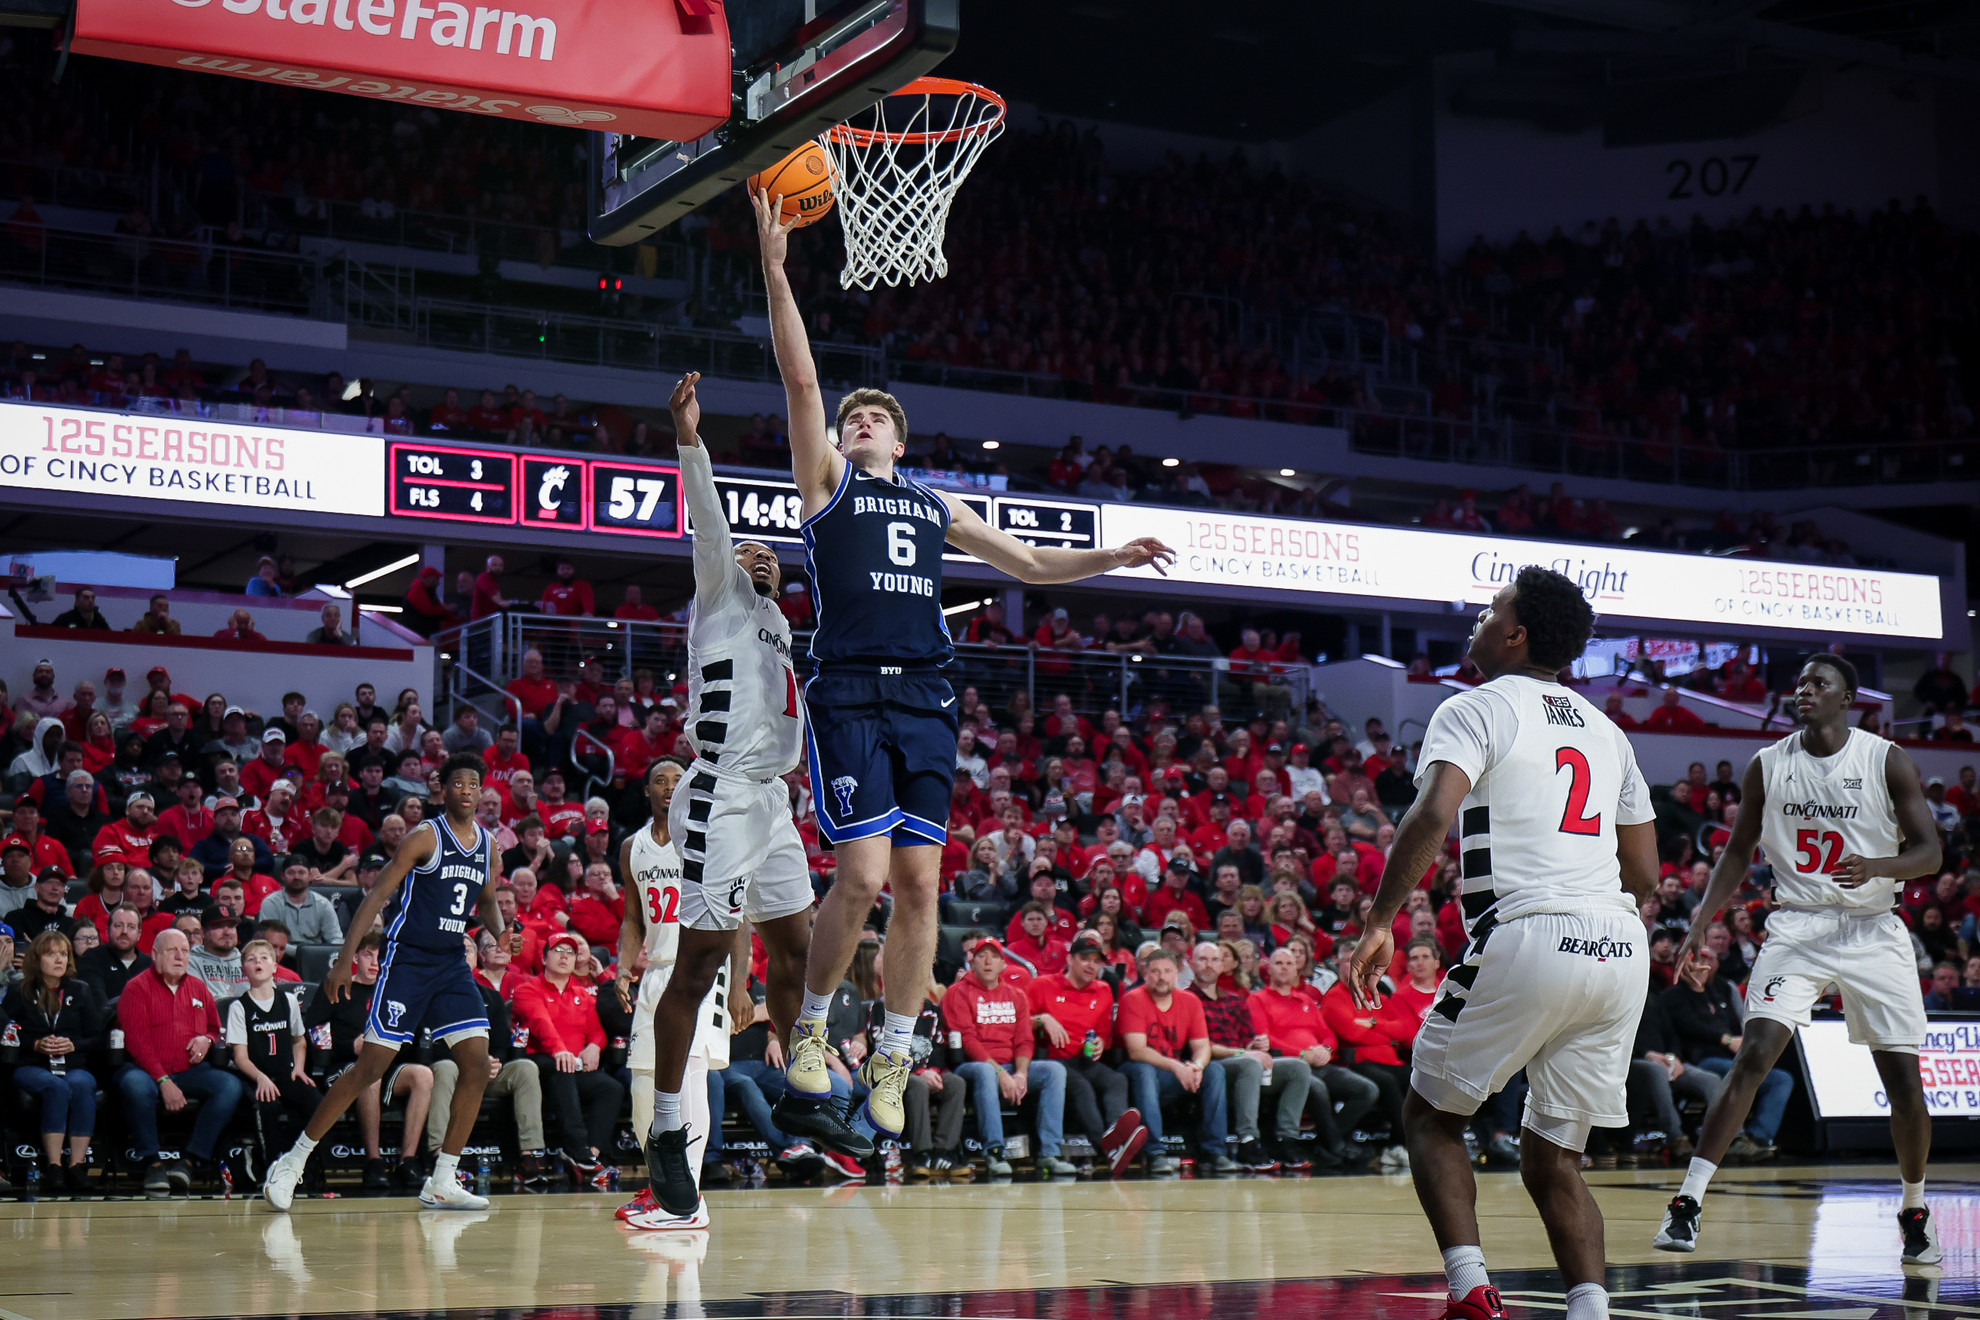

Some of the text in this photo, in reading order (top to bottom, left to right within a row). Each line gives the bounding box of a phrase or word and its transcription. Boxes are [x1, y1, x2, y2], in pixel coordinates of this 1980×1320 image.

[1667, 154, 1761, 200] 207
[0, 454, 317, 500] OF CINCY BASKETBALL
[407, 455, 483, 480] TOL 3
[409, 487, 483, 512] FLS 4
[608, 476, 665, 521] 57
[726, 490, 803, 529] 14:43
[854, 496, 942, 529] BRIGHAM
[1008, 508, 1072, 532] TOL 2
[887, 521, 917, 567] 6
[870, 571, 934, 597] YOUNG
[1189, 555, 1253, 575] CINCY
[1262, 560, 1380, 586] BASKETBALL
[1714, 597, 1901, 627] OF CINCY BASKETBALL
[880, 666, 903, 676] BYU
[781, 663, 799, 719] 1
[1542, 702, 1586, 729] JAMES
[1556, 746, 1602, 837] 2
[1783, 801, 1858, 819] CINCINNATI
[1795, 828, 1847, 876] 52
[440, 864, 485, 886] BRIGHAM
[450, 882, 468, 916] 3
[647, 885, 680, 924] 32
[1557, 936, 1633, 958] BEARCATS
[268, 1033, 277, 1056] 1
